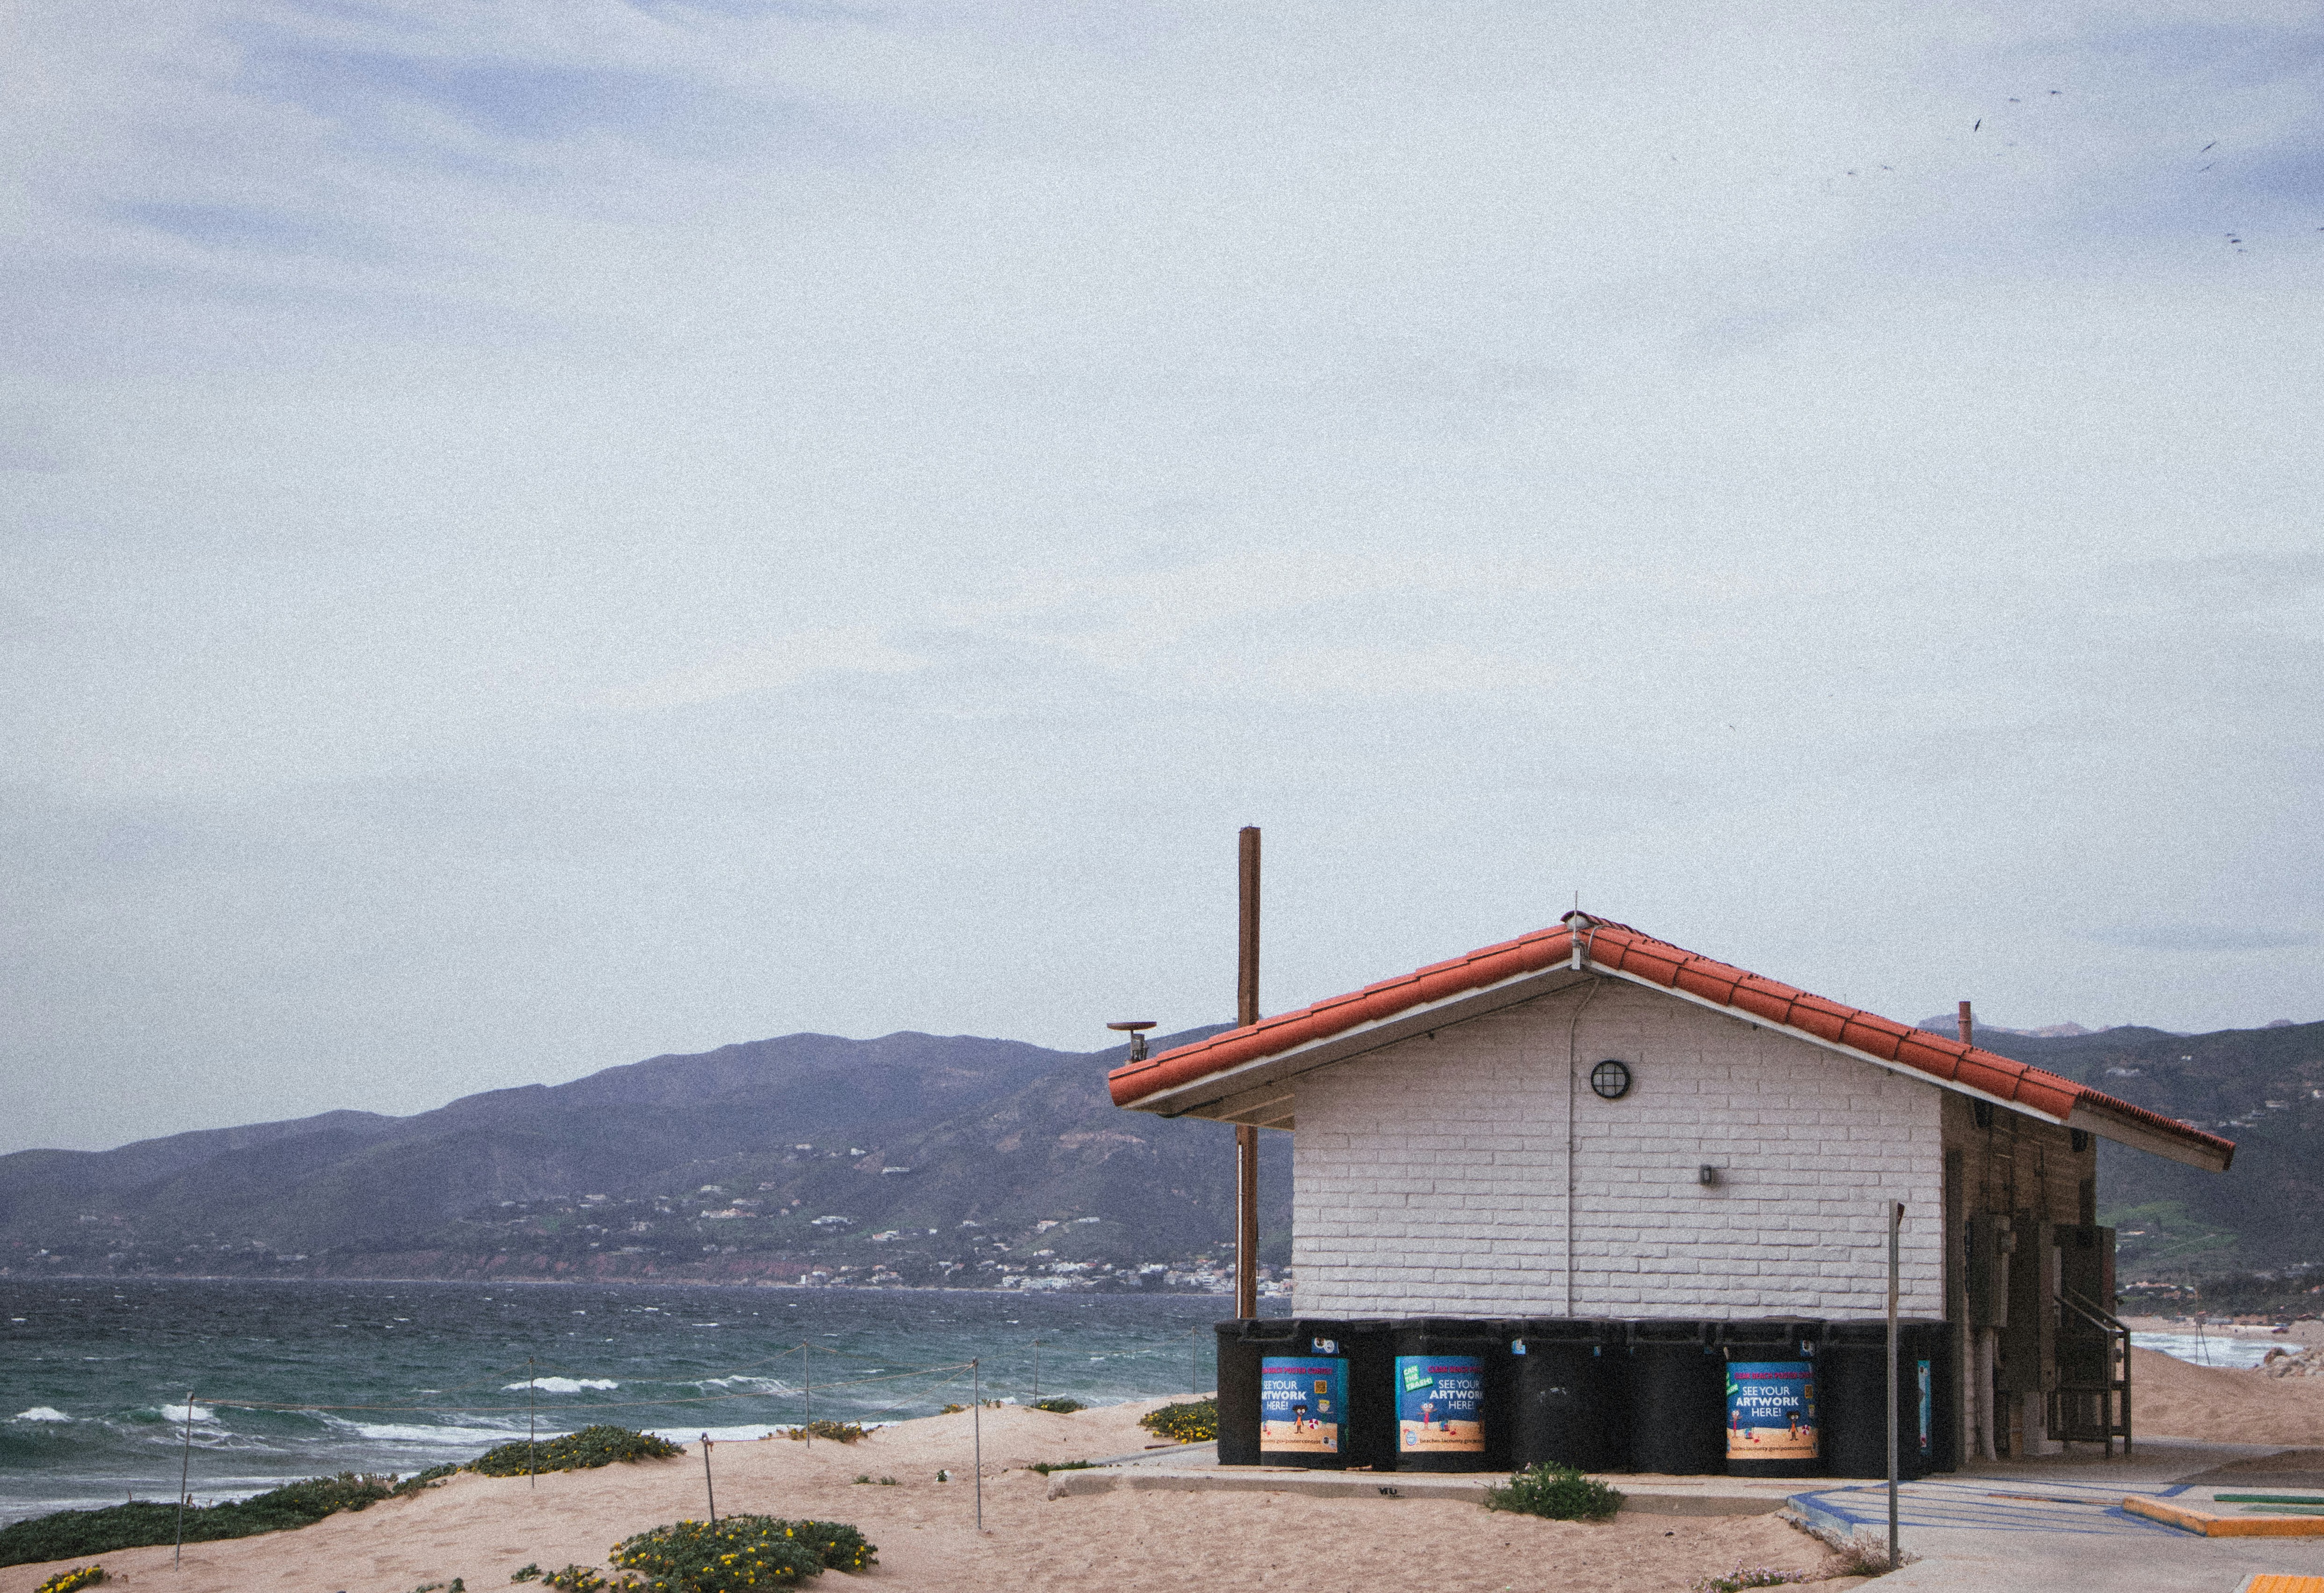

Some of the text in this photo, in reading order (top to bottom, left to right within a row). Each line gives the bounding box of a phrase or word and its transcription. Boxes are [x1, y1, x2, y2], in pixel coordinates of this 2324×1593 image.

[1403, 1366, 1418, 1375] CAN
[1263, 1380, 1297, 1389] SEE YOUR
[1438, 1380, 1480, 1389] SEE YOUR
[1429, 1390, 1483, 1399] ARTWORK
[1743, 1386, 1758, 1395] SEE
[1758, 1386, 1790, 1395] YOUR
[1267, 1401, 1288, 1410] HERE!
[1449, 1400, 1474, 1409] HERE!
[1736, 1397, 1799, 1406] ARTWORK
[1752, 1407, 1781, 1417] HERE!
